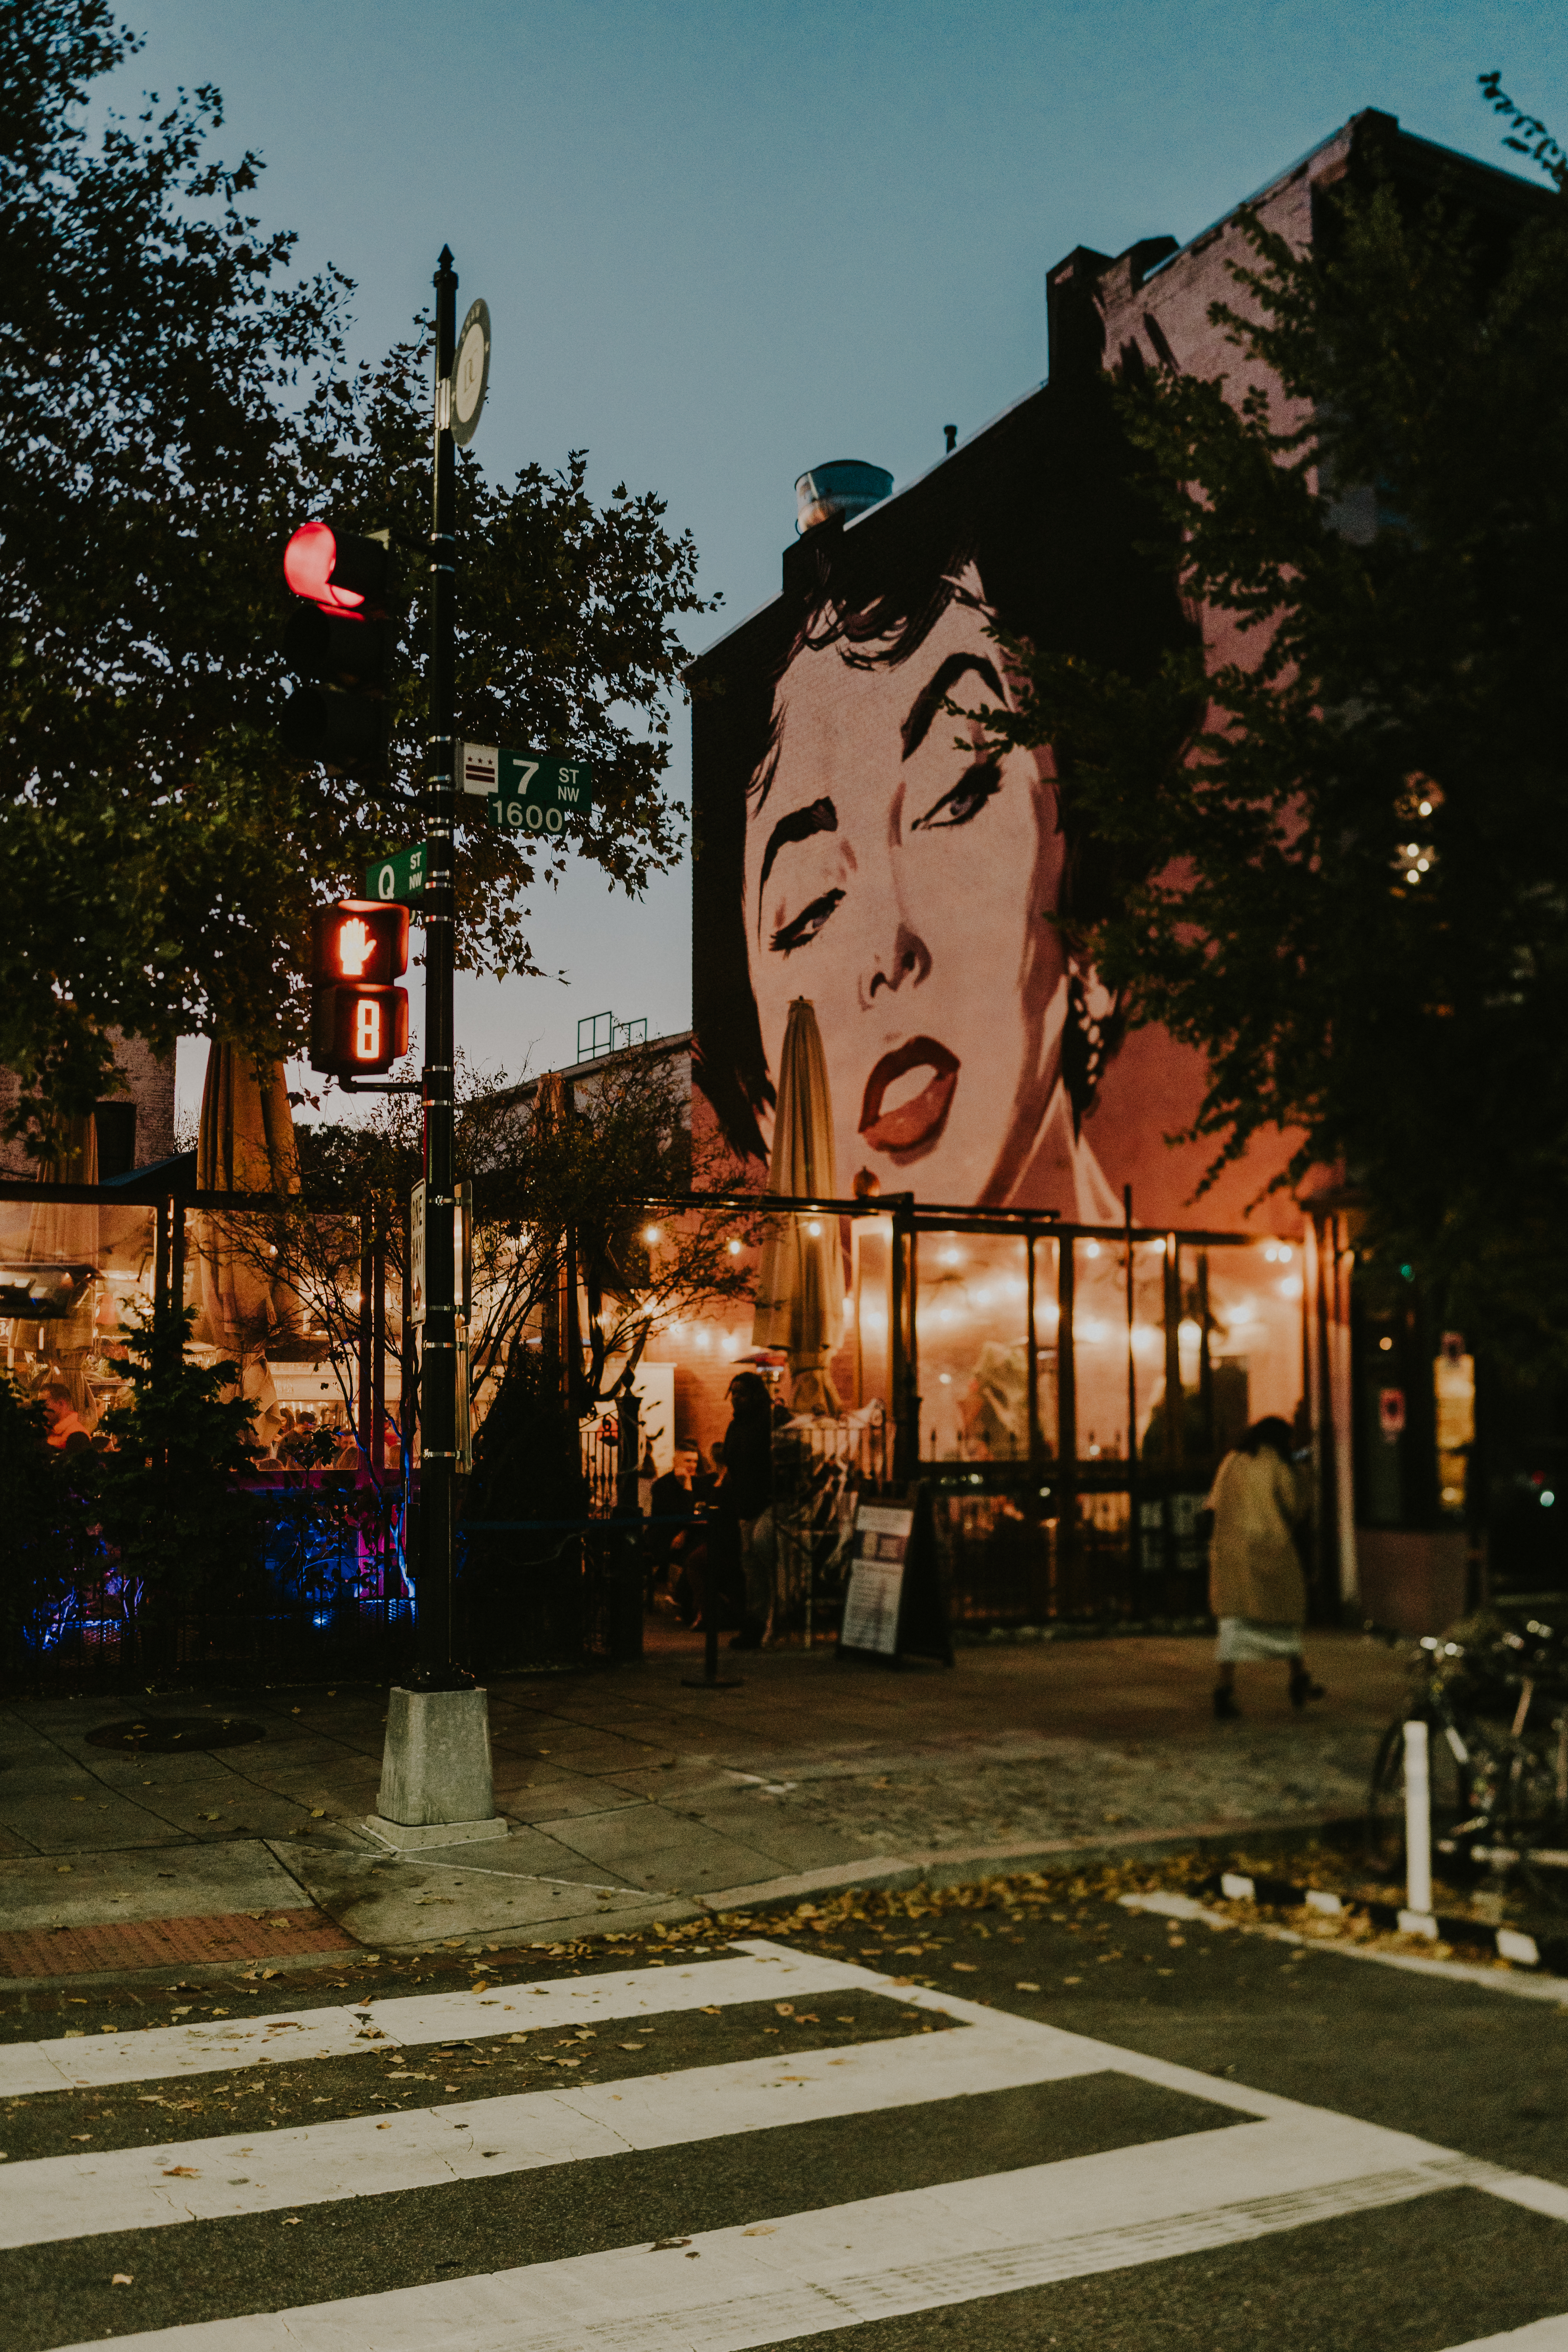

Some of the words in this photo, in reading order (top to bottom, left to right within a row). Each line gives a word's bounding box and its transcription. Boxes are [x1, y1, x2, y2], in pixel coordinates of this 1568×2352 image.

[513, 759, 539, 794] 7
[559, 767, 579, 784] ST
[558, 785, 579, 802] NW
[493, 800, 562, 832] 1600
[378, 865, 394, 900] Q
[410, 851, 422, 870] ST
[409, 871, 422, 890] NW
[357, 1000, 379, 1058] 8
[412, 1194, 423, 1231] ONE
